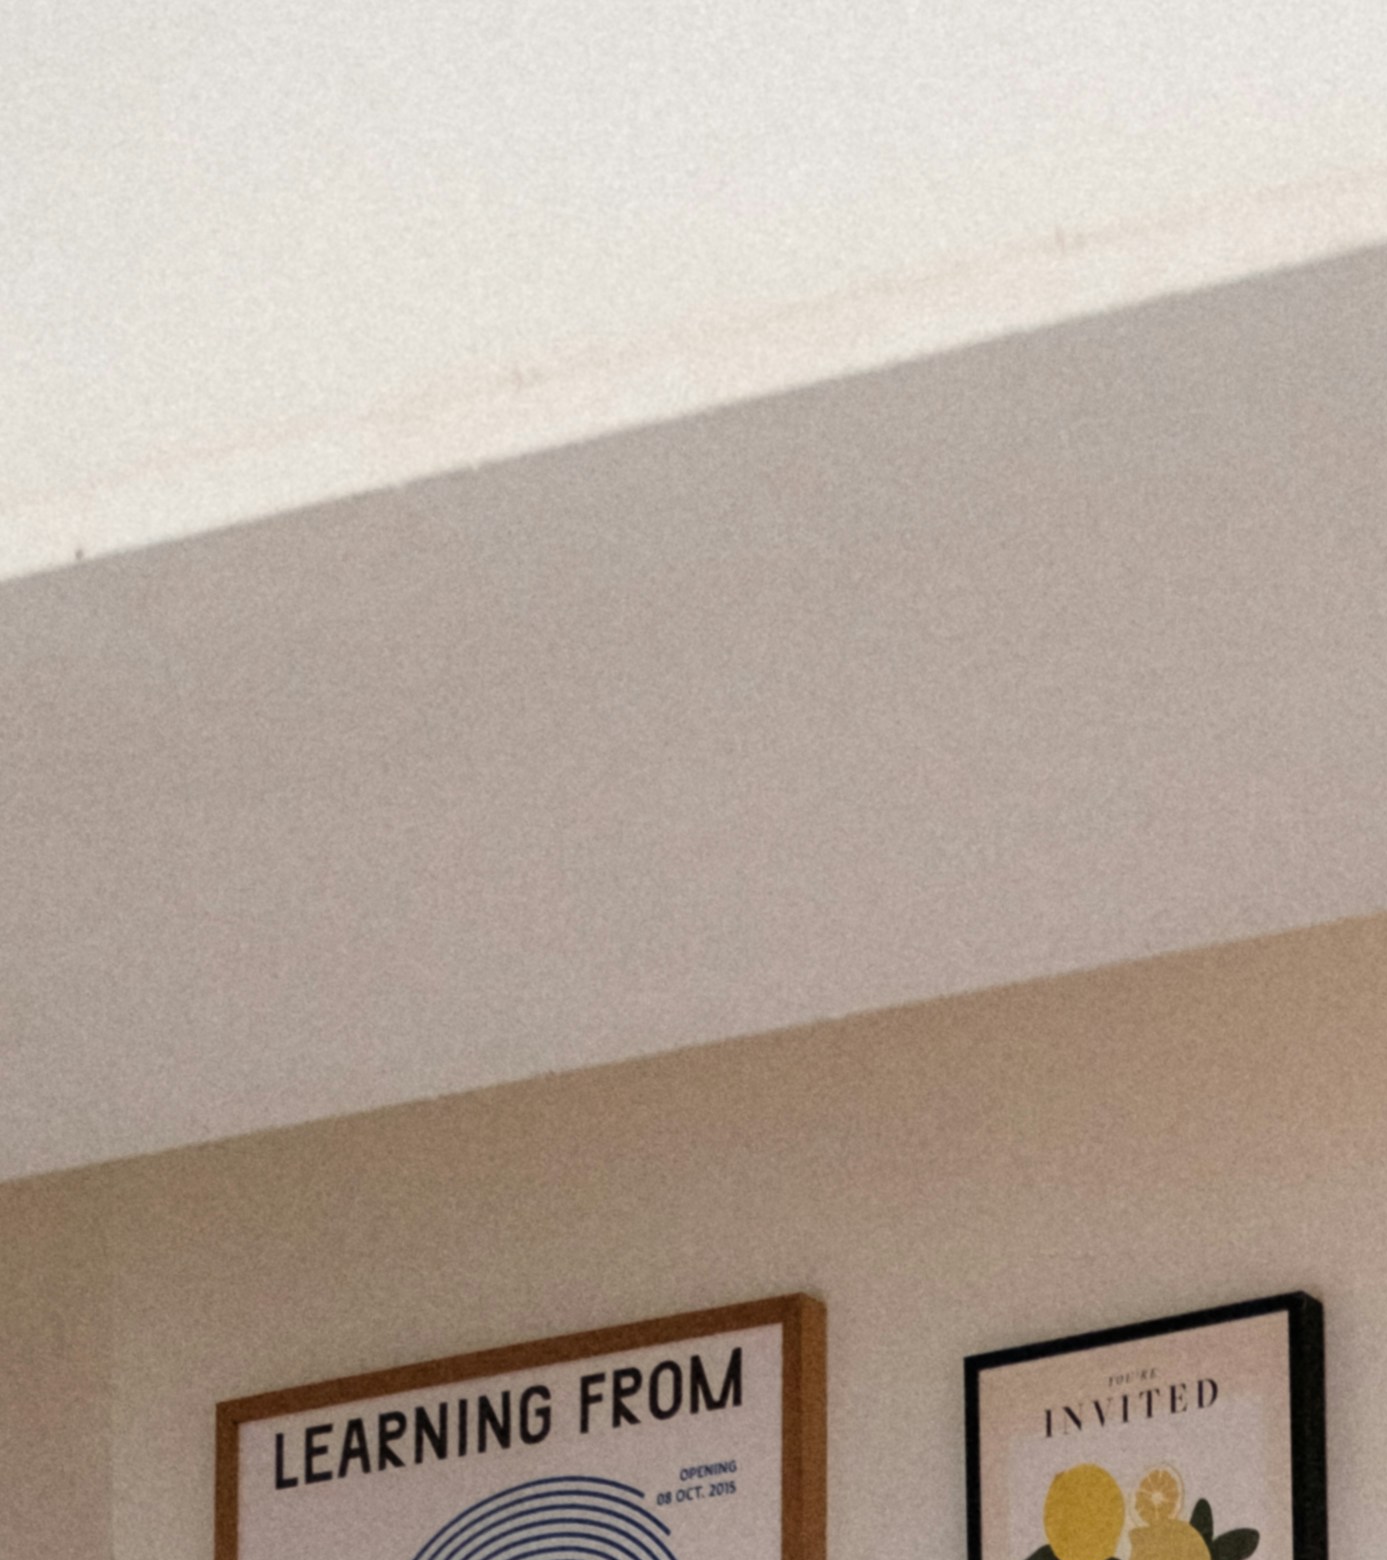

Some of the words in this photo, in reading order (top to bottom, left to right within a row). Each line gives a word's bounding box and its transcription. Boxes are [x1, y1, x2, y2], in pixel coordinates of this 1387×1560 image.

[274, 1384, 552, 1490] LEARNING
[579, 1346, 744, 1434] FROM
[1044, 1378, 1219, 1438] INVITED
[678, 1460, 738, 1482] OPENING
[656, 1490, 673, 1506] 08
[675, 1486, 706, 1503] OCT.
[708, 1480, 738, 1498] 2015
